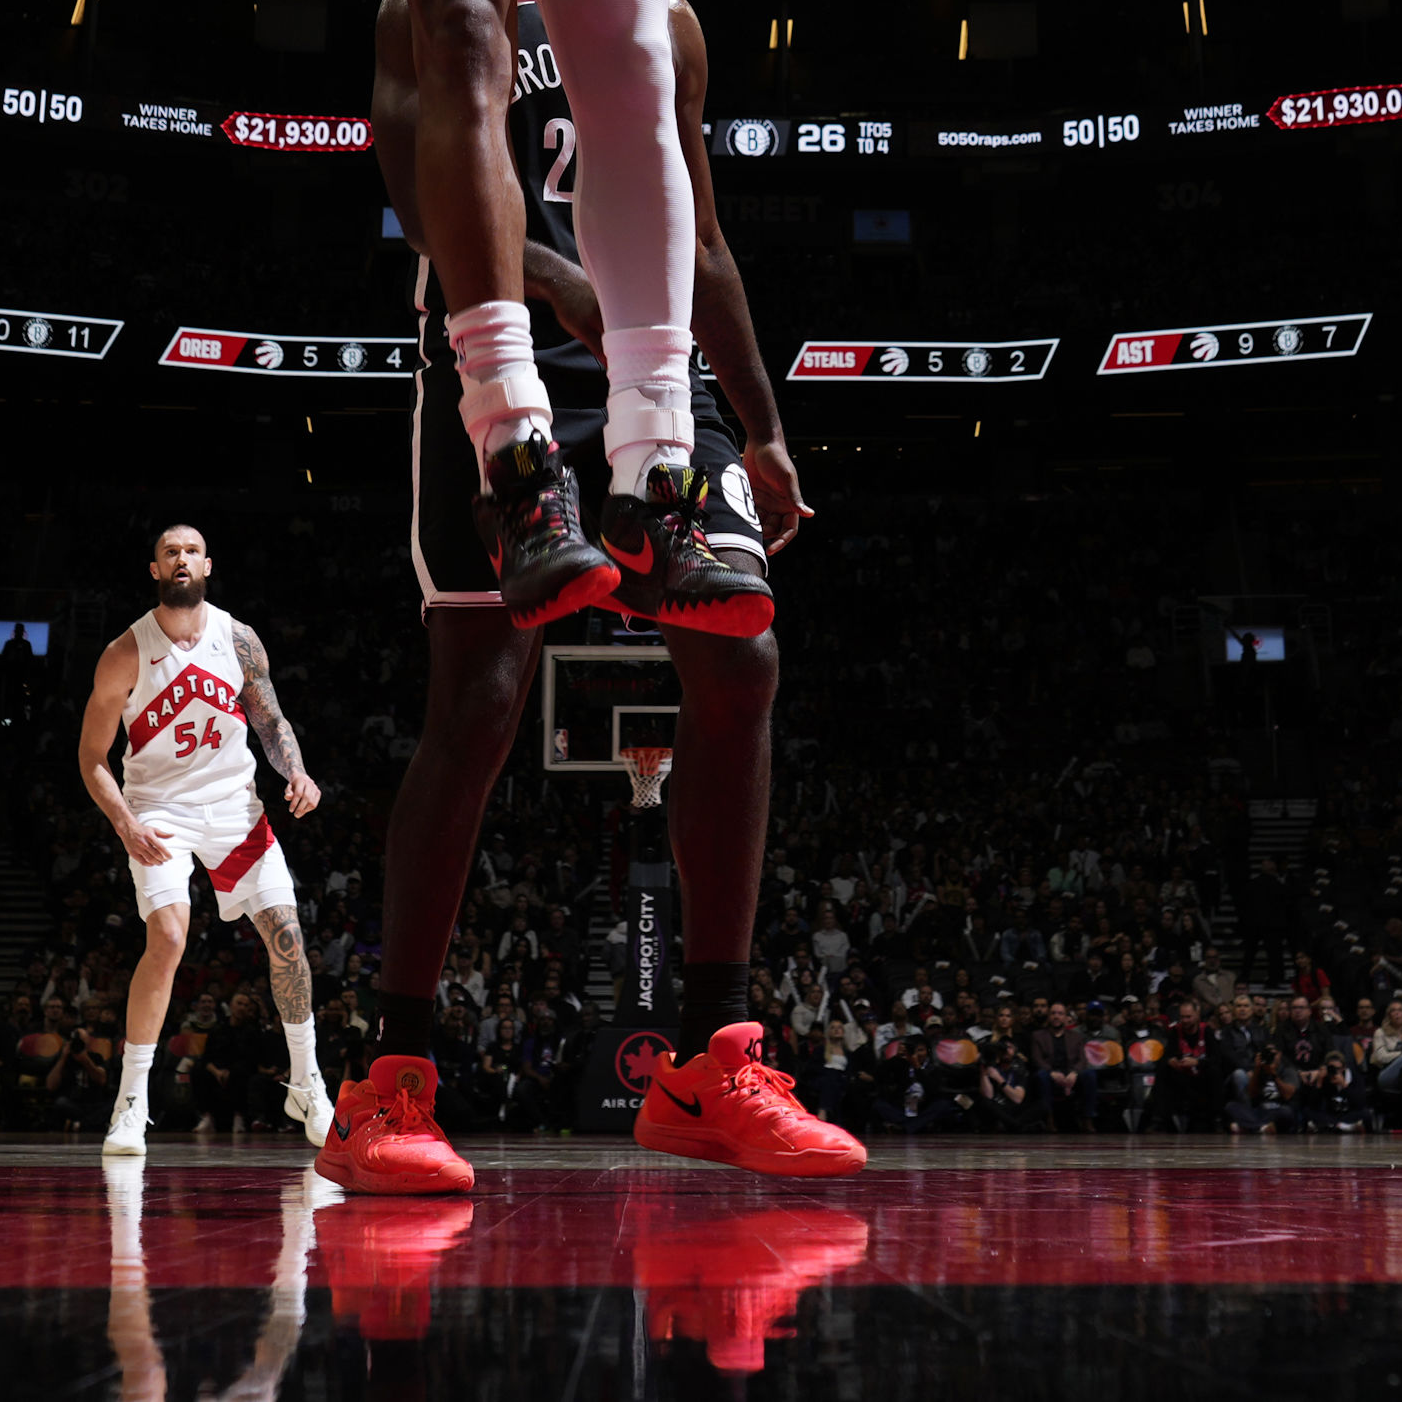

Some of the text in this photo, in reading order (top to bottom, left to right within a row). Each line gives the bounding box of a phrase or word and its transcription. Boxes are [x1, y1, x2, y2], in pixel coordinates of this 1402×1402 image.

[139, 103, 197, 122] WINNER
[1184, 104, 1243, 121] WINNER
[122, 114, 212, 136] TAKES HOME
[235, 114, 367, 149] $21,930.00
[1168, 114, 1260, 135] TAKES HOME
[798, 124, 845, 152] 26
[877, 139, 889, 154] 4
[938, 131, 1041, 147] 5050raps.com
[68, 326, 90, 348] 11
[1117, 326, 1337, 366] AST 9 7
[179, 338, 402, 368] OREB 5 4
[803, 350, 1025, 372] STEALS 5 2
[147, 674, 236, 728] RAPTORS
[174, 716, 222, 758] 54
[638, 893, 654, 1011] JACKPOT CITY
[601, 1098, 626, 1109] AIR
